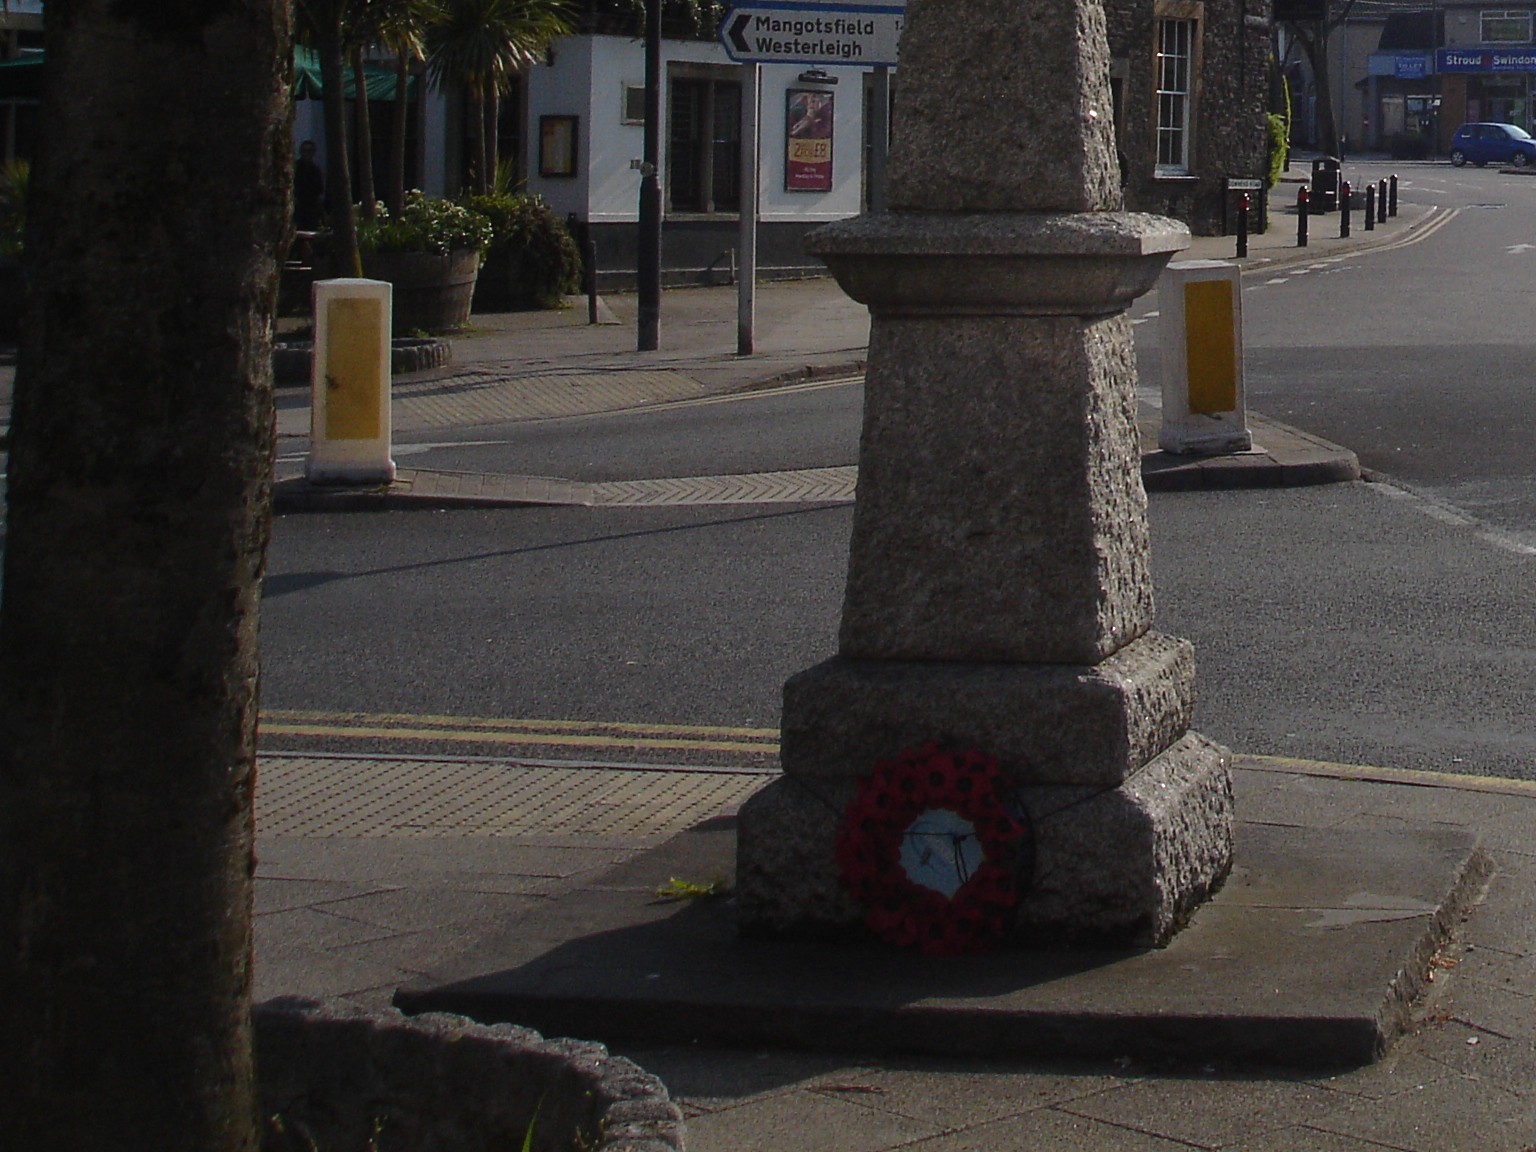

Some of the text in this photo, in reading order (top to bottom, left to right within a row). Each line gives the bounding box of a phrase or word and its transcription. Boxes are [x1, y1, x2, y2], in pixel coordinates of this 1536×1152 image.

[755, 16, 874, 35] Mangotsfield
[755, 38, 862, 58] Westerleigh
[1445, 55, 1482, 66] Stroud
[1493, 55, 1536, 65] Swindon
